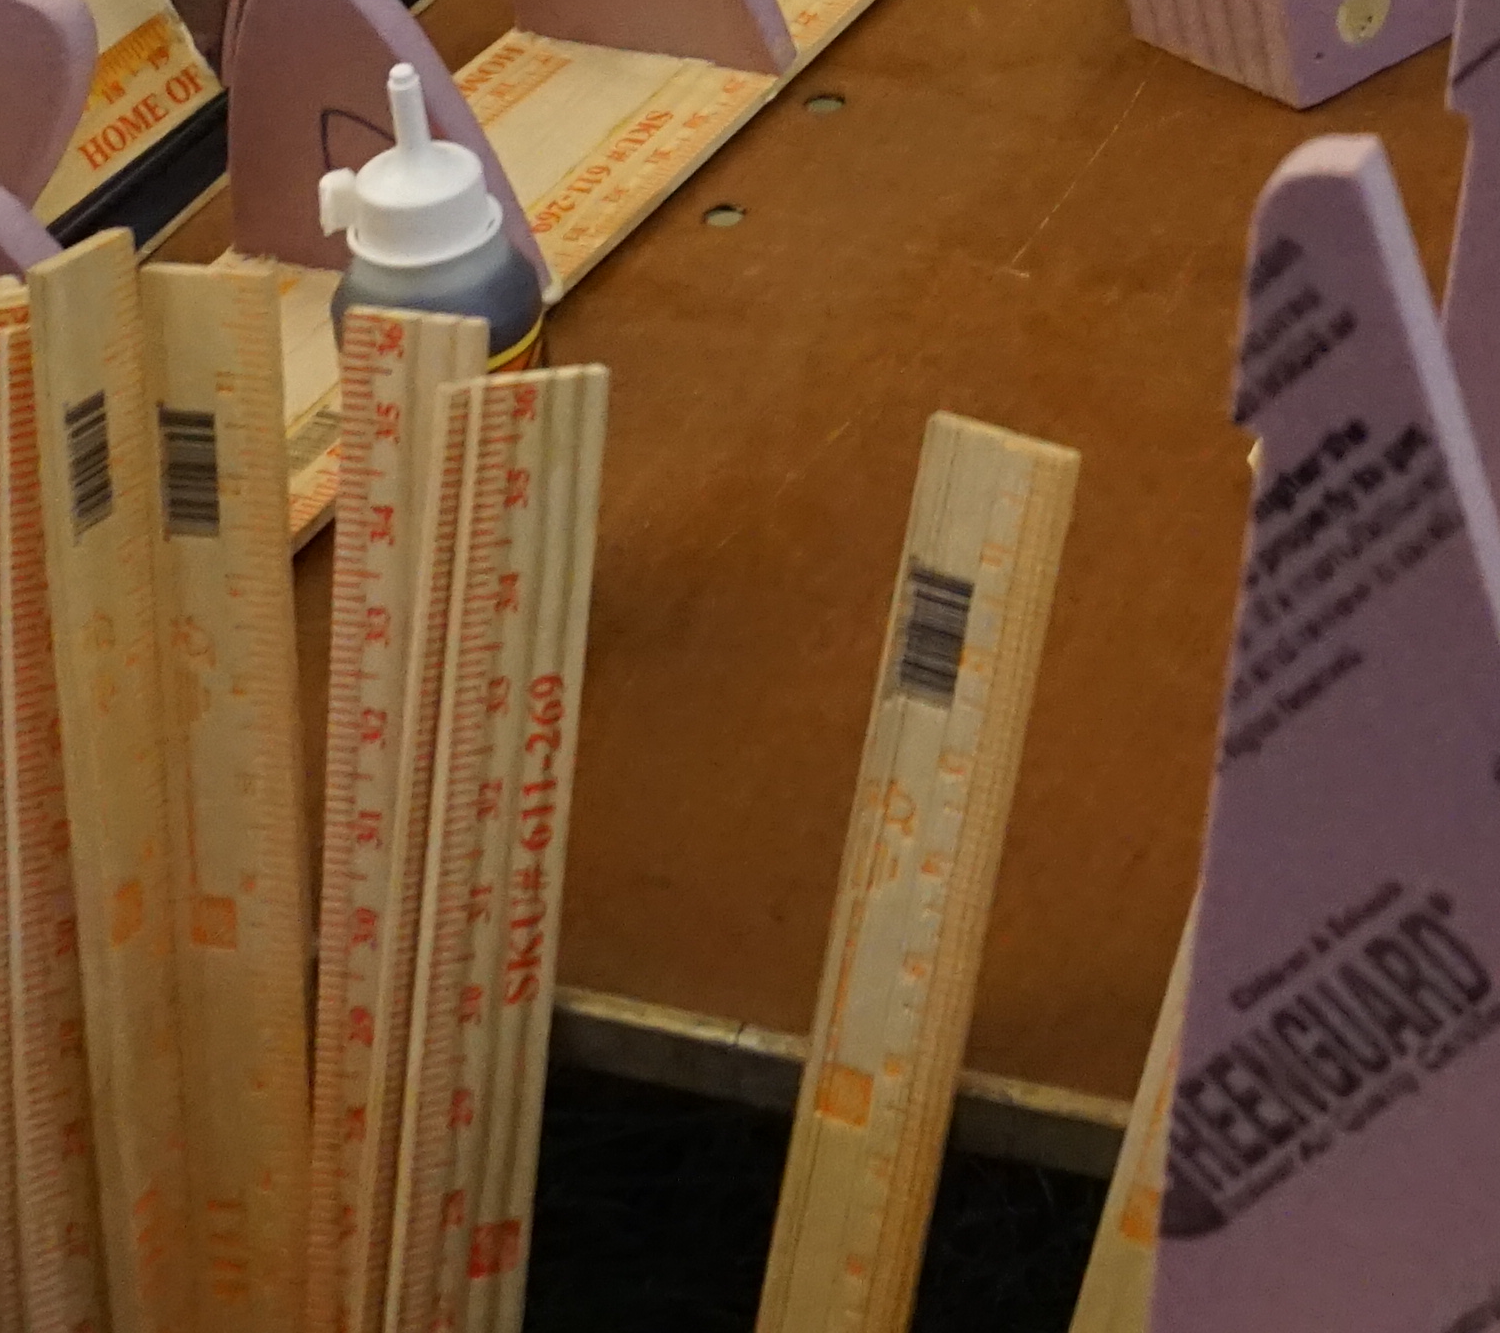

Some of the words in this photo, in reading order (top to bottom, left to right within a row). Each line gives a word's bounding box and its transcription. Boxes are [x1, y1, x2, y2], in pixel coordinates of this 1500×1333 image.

[77, 93, 168, 171] HOME
[164, 64, 204, 105] OF
[520, 672, 564, 851] 611-269
[506, 861, 547, 1004] SKU#
[1168, 913, 1493, 1193] REENGUARD
